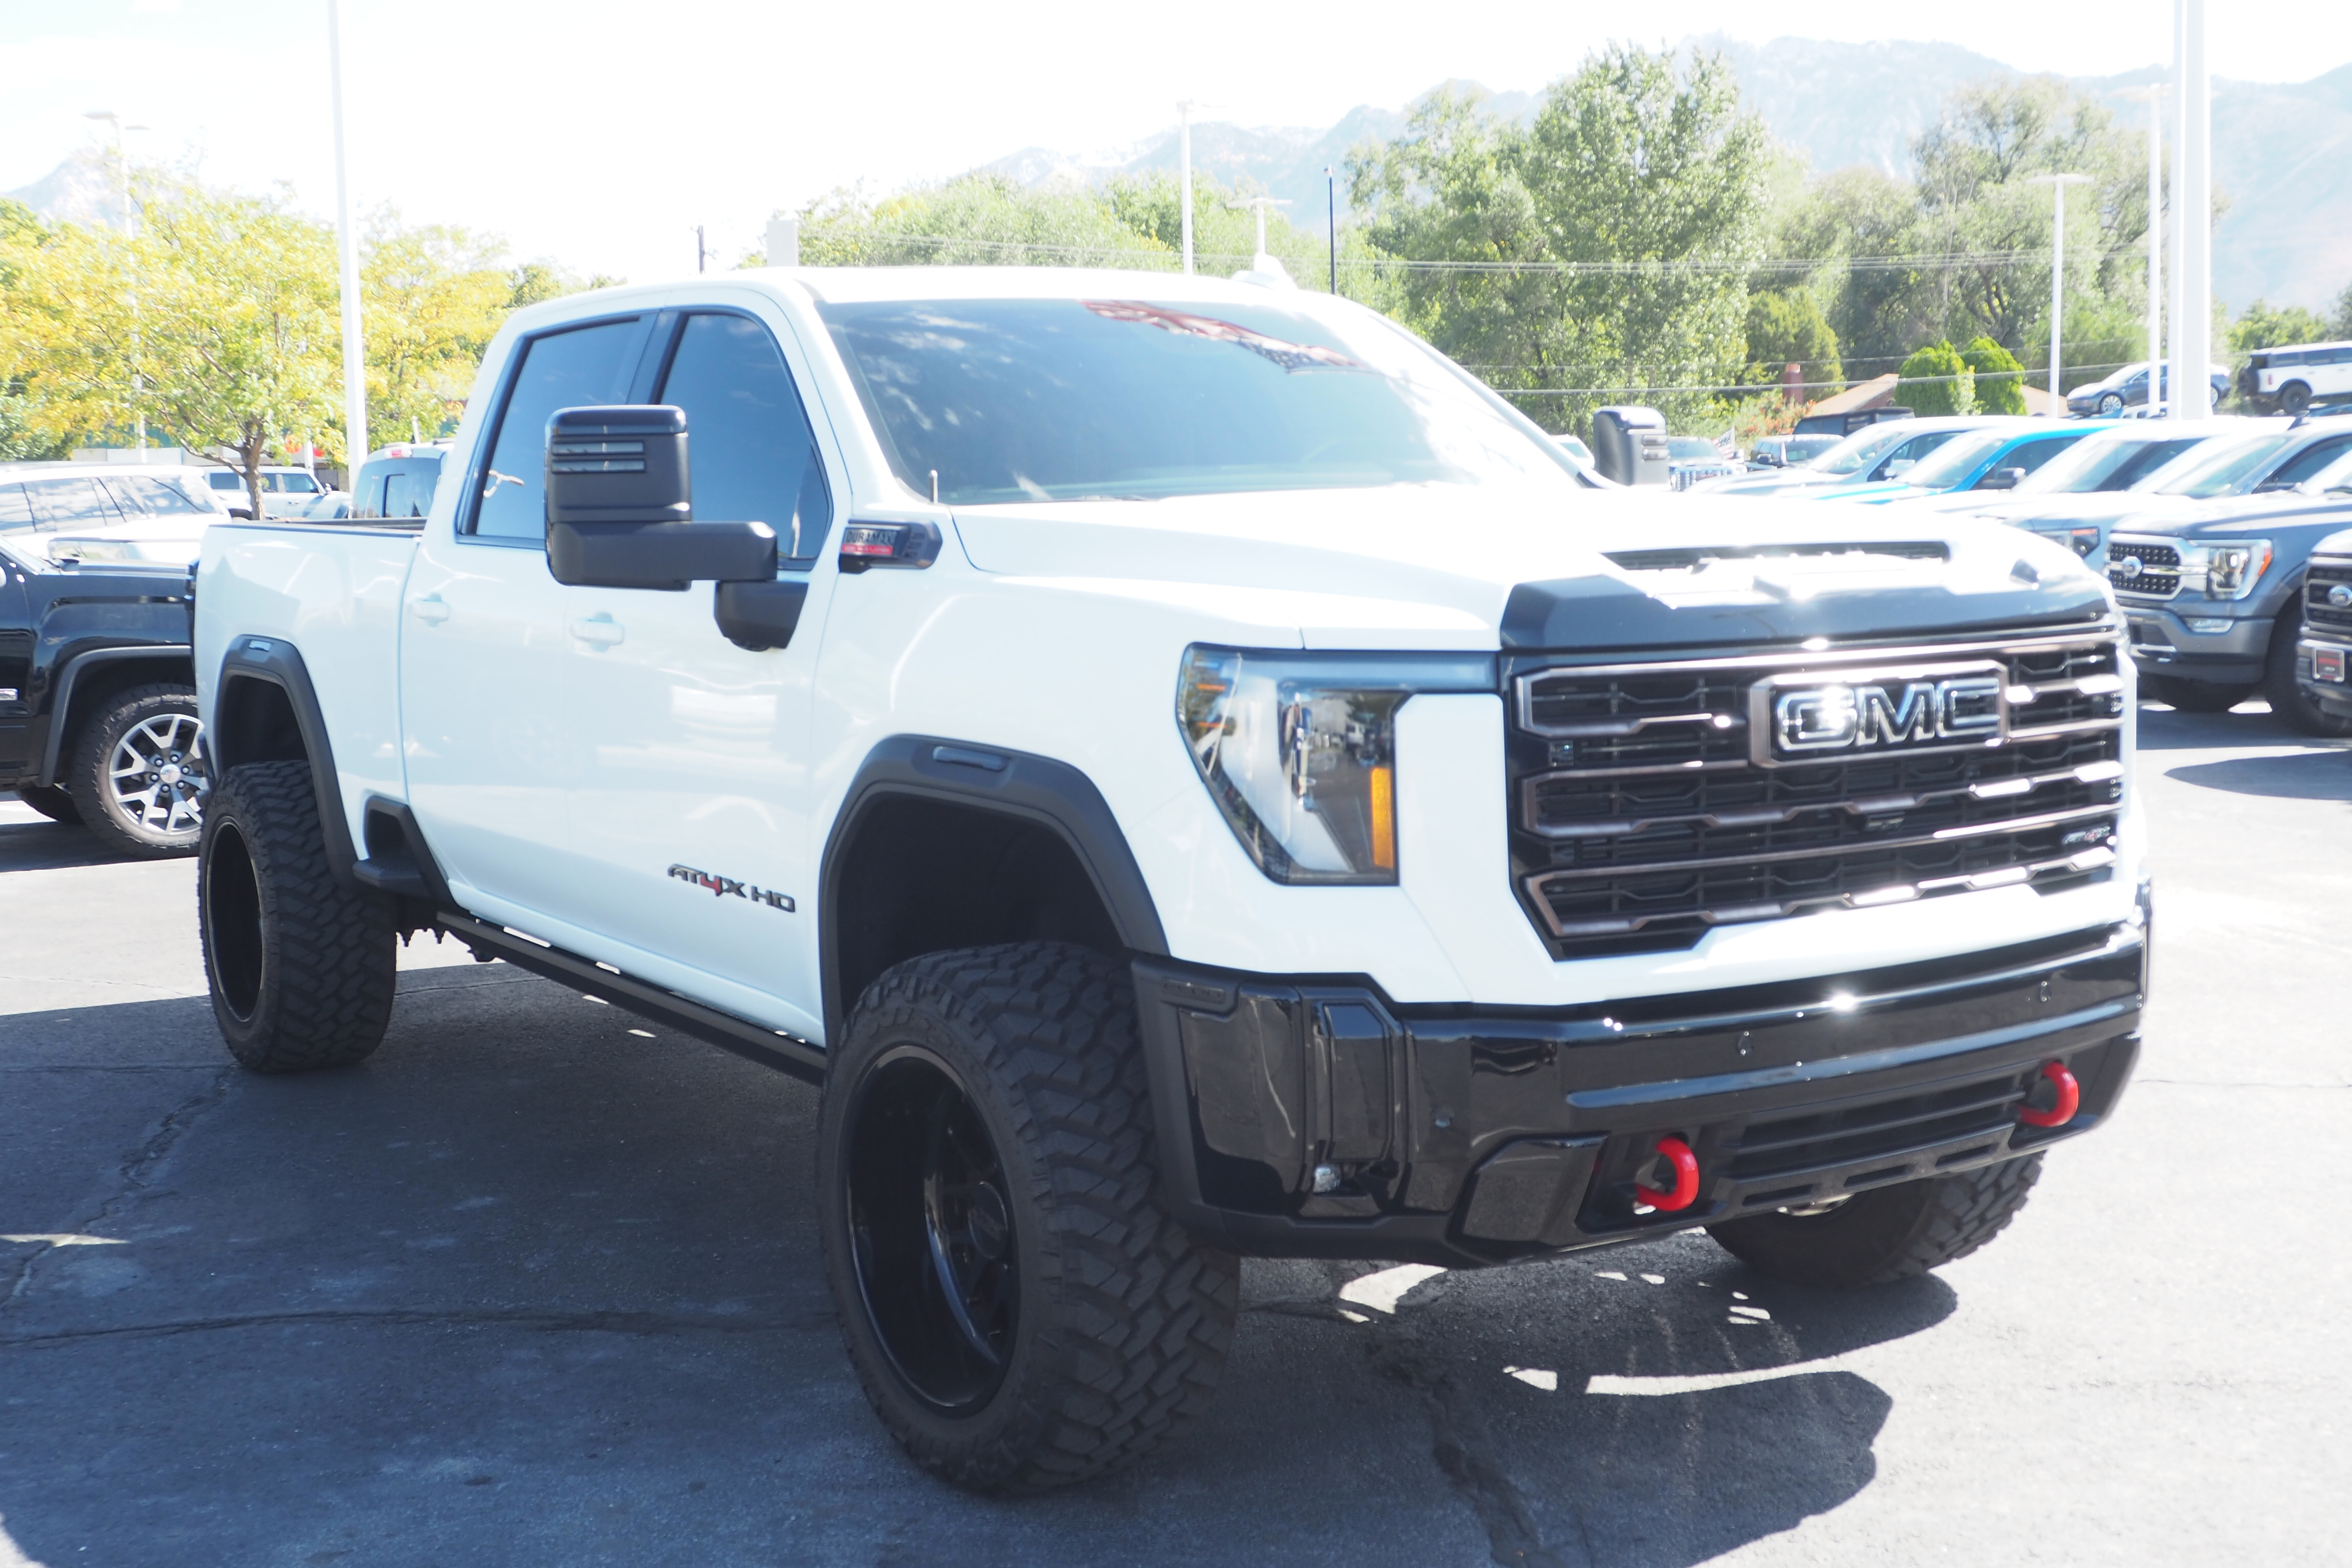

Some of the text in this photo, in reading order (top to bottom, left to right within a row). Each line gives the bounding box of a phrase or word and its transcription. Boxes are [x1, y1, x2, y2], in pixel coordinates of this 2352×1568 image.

[845, 530, 896, 545] DURAMAX
[1777, 677, 2000, 751] GMC
[668, 864, 795, 913] AT4X HD
